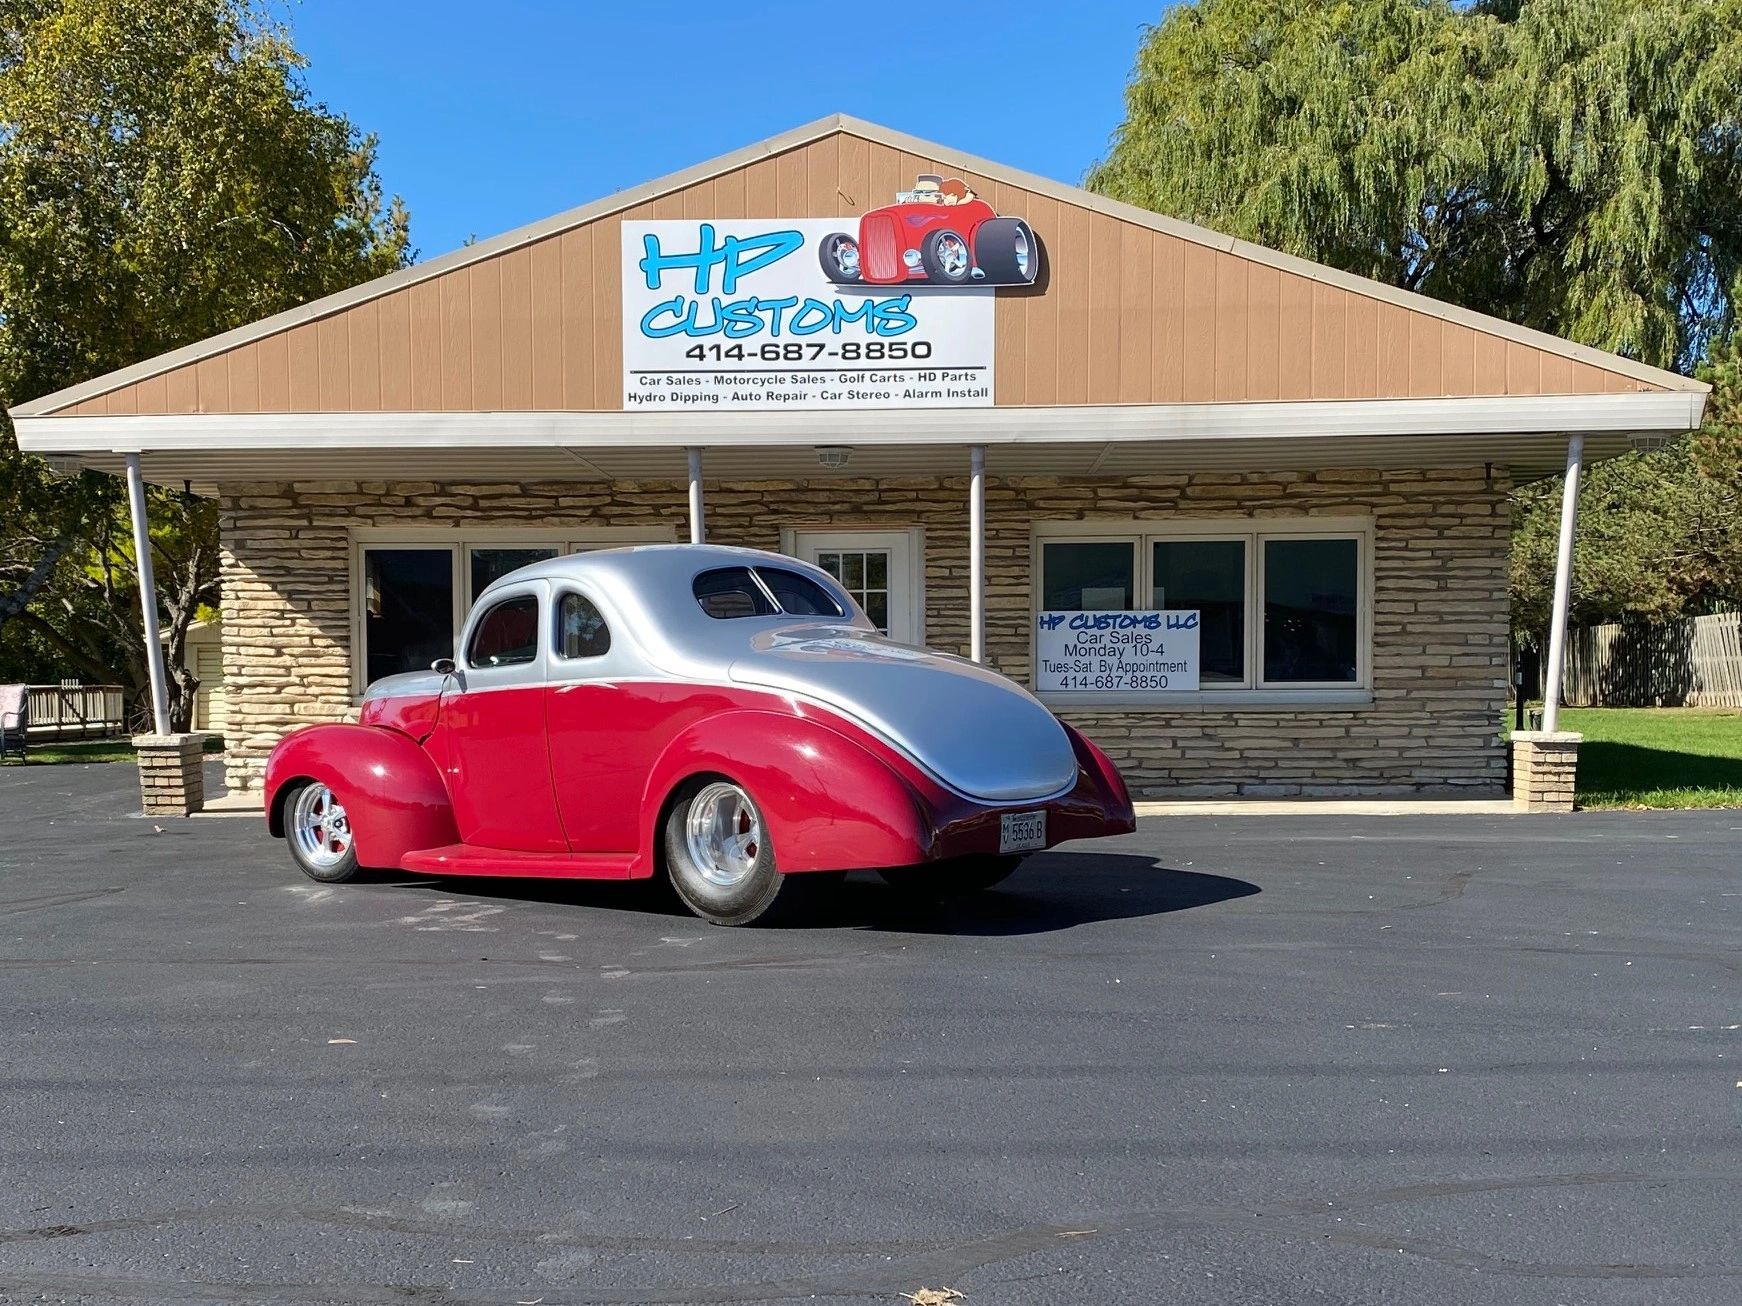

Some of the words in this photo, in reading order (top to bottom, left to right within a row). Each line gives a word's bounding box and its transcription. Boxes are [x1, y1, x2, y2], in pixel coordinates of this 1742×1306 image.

[639, 223, 804, 294] HP
[640, 294, 917, 339] CUSTOMS
[685, 341, 932, 362] 414-687-8850
[639, 376, 662, 386] Car
[666, 375, 701, 386] Sales
[714, 374, 786, 387] Motorcycle
[790, 374, 826, 385] Sales
[839, 373, 865, 384] Golf
[869, 373, 905, 383] Carts
[918, 372, 937, 382] HD
[941, 372, 977, 382] Parts
[628, 392, 666, 404] Hydro
[670, 391, 719, 404] Dipping
[731, 391, 762, 402] Auto
[766, 391, 808, 403] Repair
[820, 390, 843, 400] Car
[847, 389, 890, 400] Stereo
[903, 388, 942, 399] Alarm
[947, 387, 988, 398] Install
[1039, 613, 1066, 630] HP
[1069, 613, 1161, 630] CUSTOMS
[1166, 613, 1198, 630] LLC
[1076, 631, 1105, 644] Car
[1109, 631, 1153, 645] Sales
[1064, 643, 1125, 659] Monday
[1132, 643, 1165, 657] 10-4
[1042, 659, 1095, 673] Tues-Sat.
[1099, 660, 1115, 676] By
[1116, 660, 1188, 676] Appointment
[1060, 675, 1168, 689] 414-687-8850
